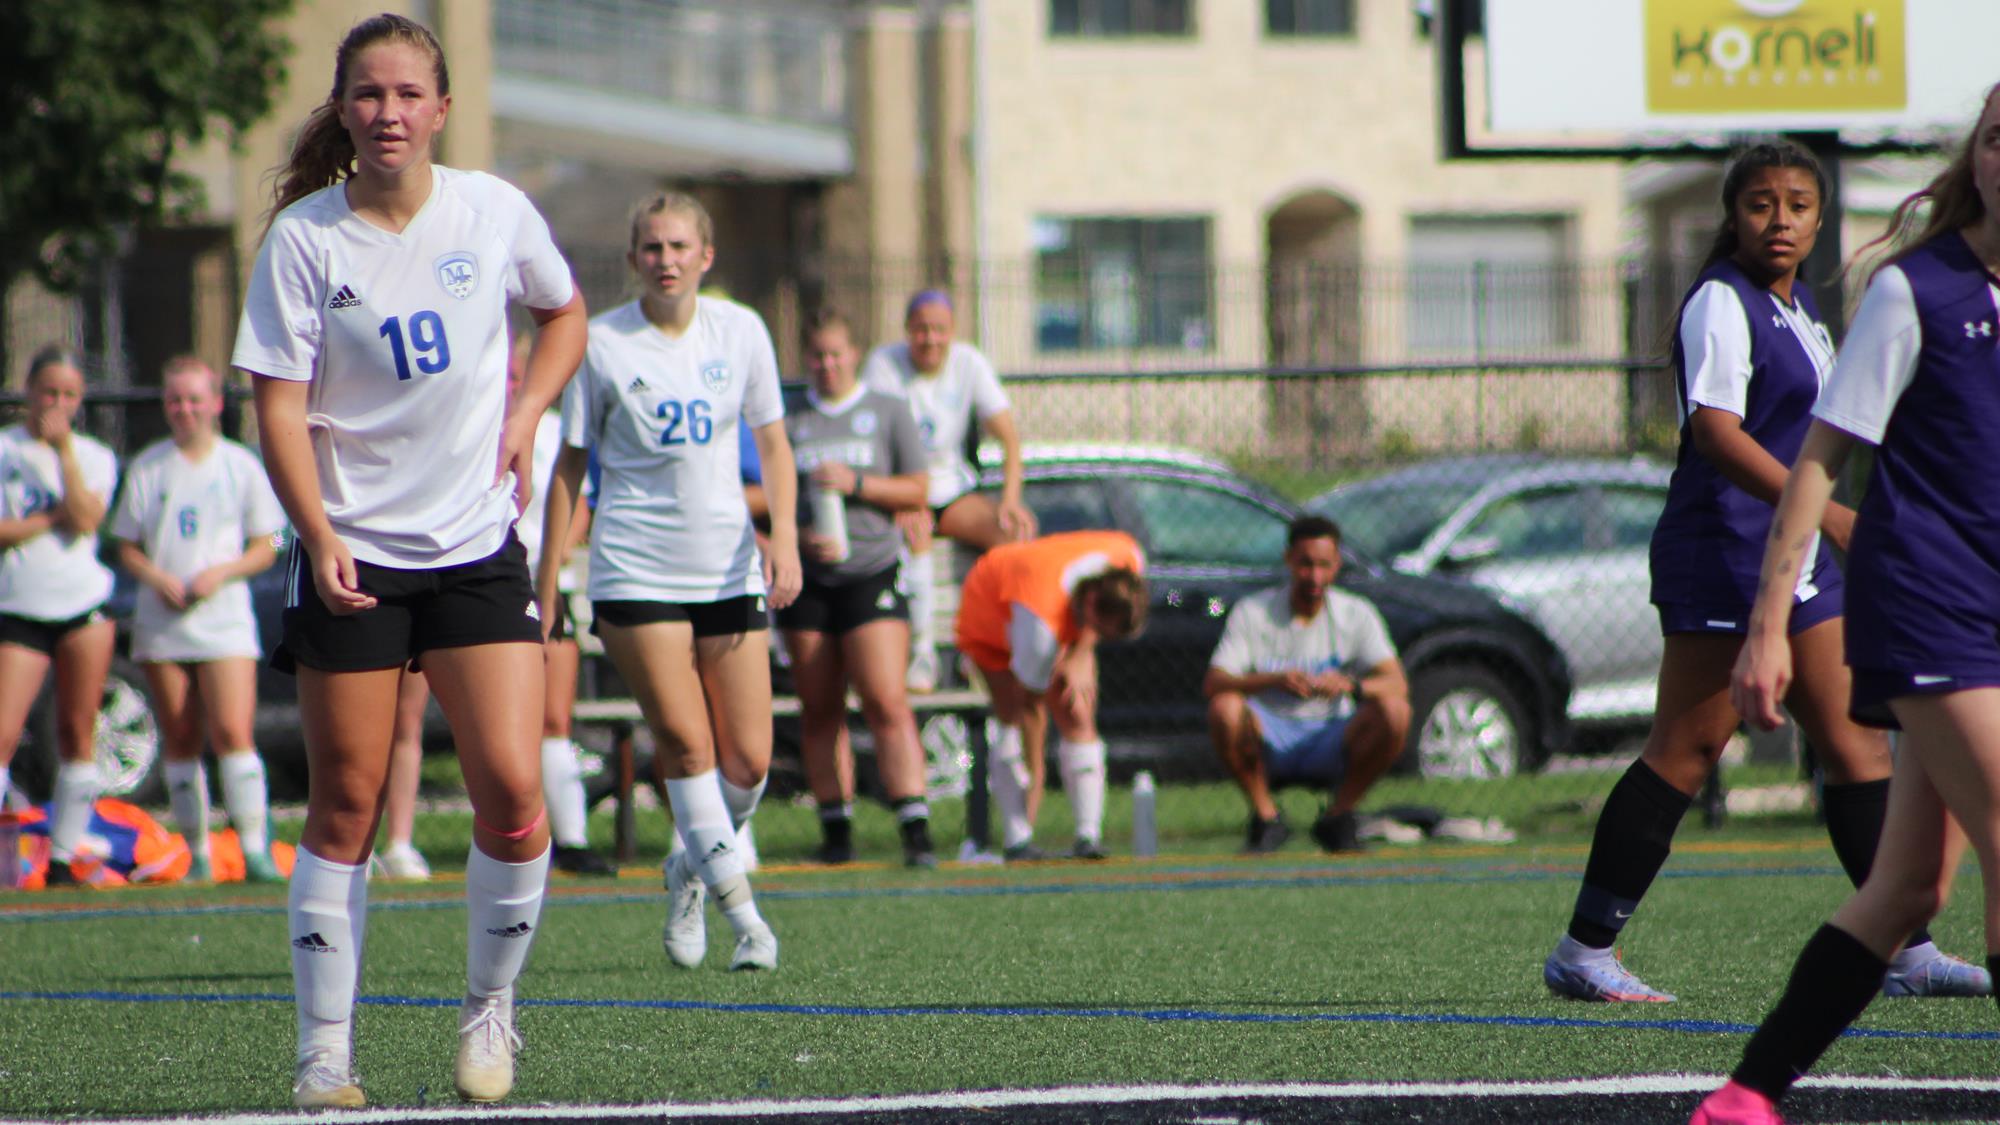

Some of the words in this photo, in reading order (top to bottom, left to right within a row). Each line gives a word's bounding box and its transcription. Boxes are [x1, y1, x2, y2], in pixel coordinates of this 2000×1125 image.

[328, 298, 362, 309] adidas
[379, 310, 451, 381] 19
[656, 399, 713, 446] 26
[179, 505, 199, 539] 6
